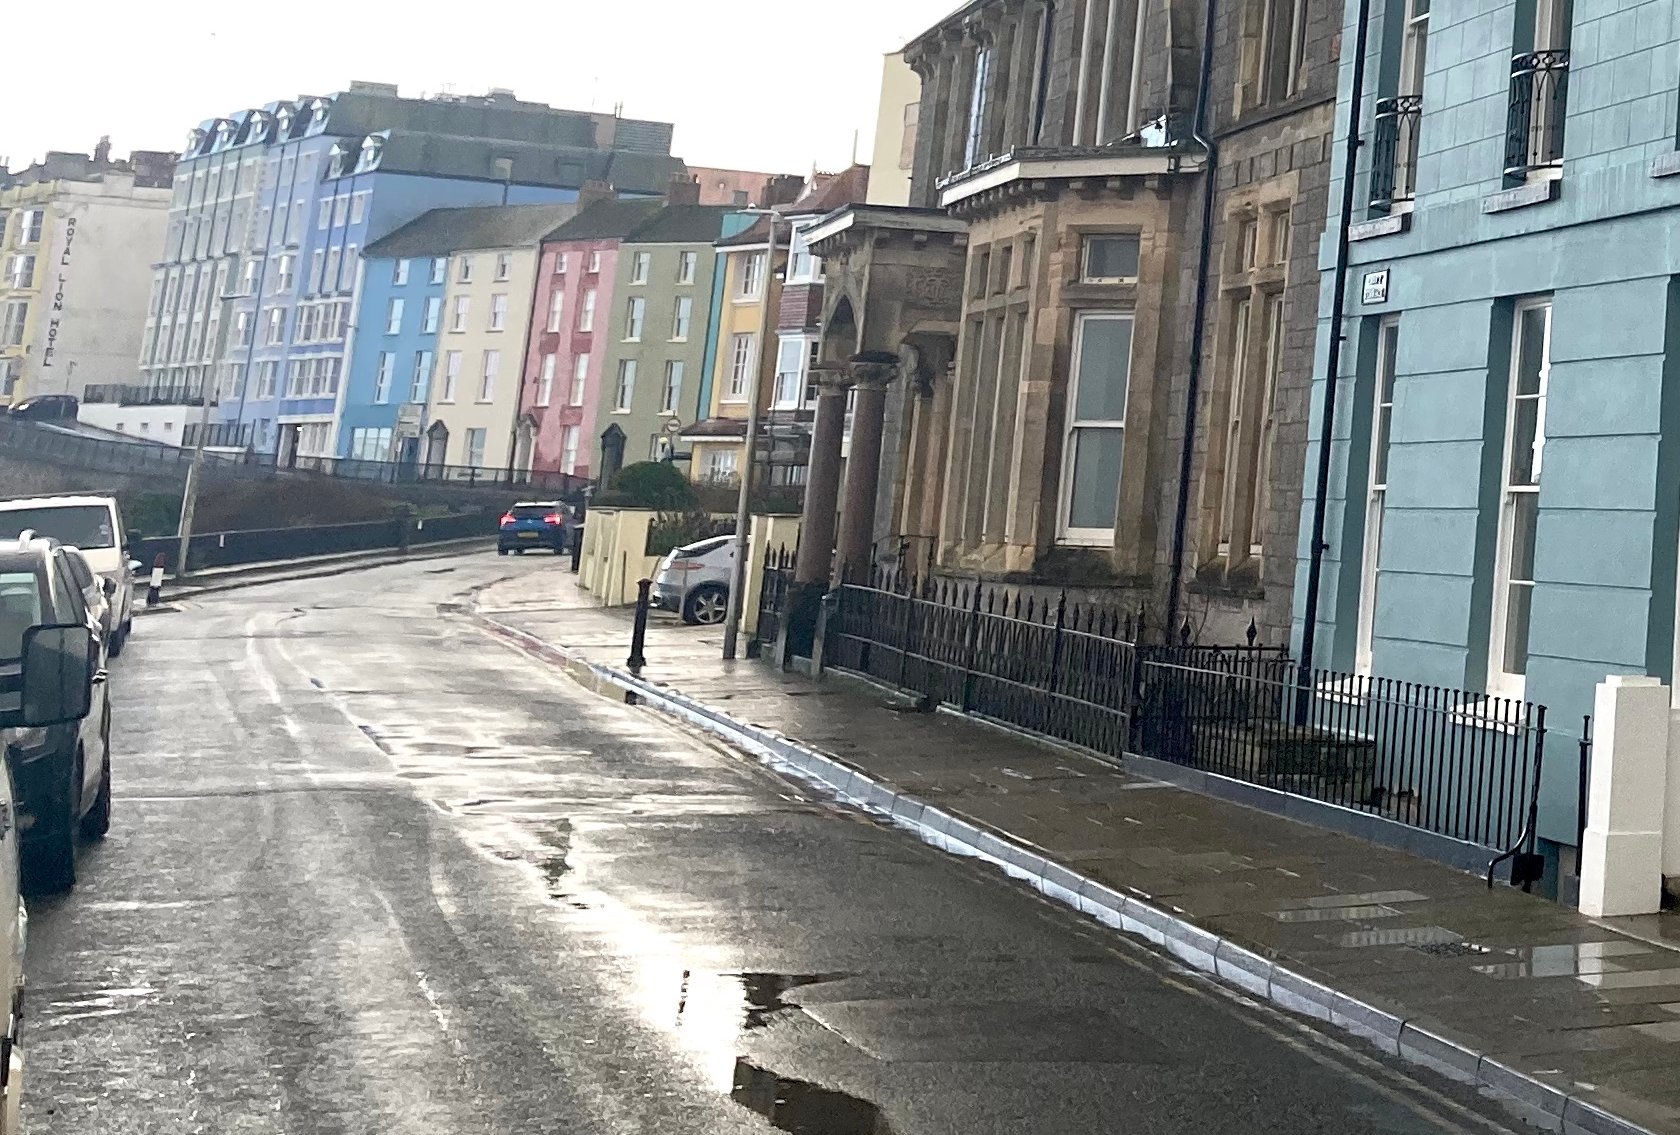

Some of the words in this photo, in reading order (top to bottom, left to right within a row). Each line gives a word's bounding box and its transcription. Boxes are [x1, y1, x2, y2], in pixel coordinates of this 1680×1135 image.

[61, 217, 77, 266] ROYAL
[53, 272, 67, 311] LION
[42, 319, 60, 367] HOTEL
